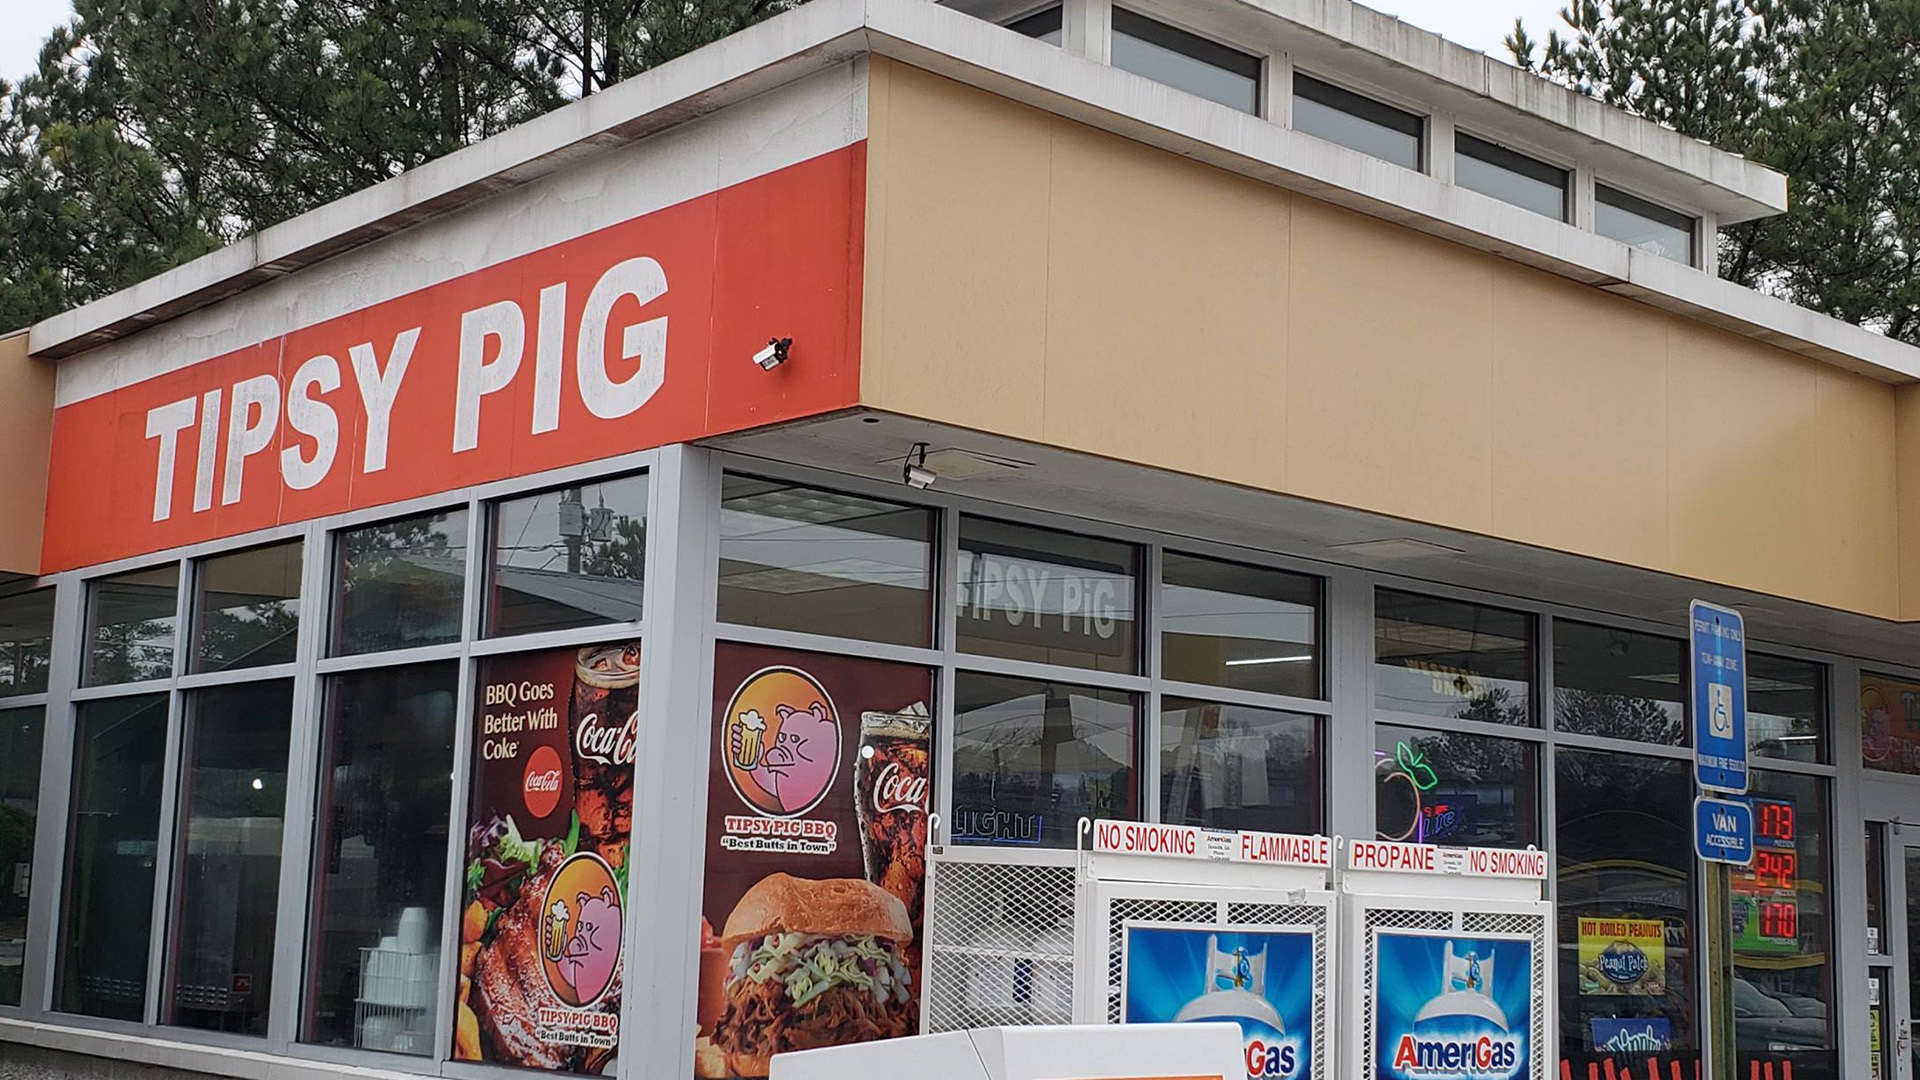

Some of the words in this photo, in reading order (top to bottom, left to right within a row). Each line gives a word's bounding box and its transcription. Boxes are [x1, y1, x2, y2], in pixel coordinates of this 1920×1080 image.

[145, 327, 421, 522] TIPSY
[453, 257, 668, 453] PIG
[486, 683, 517, 708] BBQ
[519, 681, 555, 702] Goes
[484, 712, 526, 735] Better
[527, 707, 558, 731] With
[483, 737, 518, 760] Coke
[873, 762, 927, 813] Coca
[726, 817, 770, 832] TIPSY
[773, 819, 801, 834] PIG
[803, 822, 835, 838] BBQ
[1712, 812, 1737, 833] VAN
[755, 839, 784, 851] Butts
[786, 841, 798, 851] in
[1099, 823, 1120, 850] NO
[1125, 826, 1195, 855] SMOKING
[1241, 834, 1328, 864] FLAMMABLE
[1705, 834, 1745, 850] ACCESSIBLE
[1353, 843, 1435, 871] PROPANE
[1469, 850, 1488, 873] NO
[1490, 851, 1544, 876] SMOKING
[1757, 852, 1794, 890] 242
[1581, 921, 1597, 936] HOT
[1599, 922, 1626, 937] BOILED
[1629, 923, 1662, 939] PEANUTS
[1600, 954, 1626, 972] Peanut
[1628, 954, 1649, 972] Patch
[540, 1009, 570, 1024] TIPSY
[572, 1013, 591, 1026] PIG
[593, 1015, 617, 1031] BBQ
[559, 1032, 579, 1043] Butts
[580, 1034, 588, 1044] in
[1245, 1040, 1296, 1077] Gas
[1394, 1035, 1516, 1069] AmeriGas
